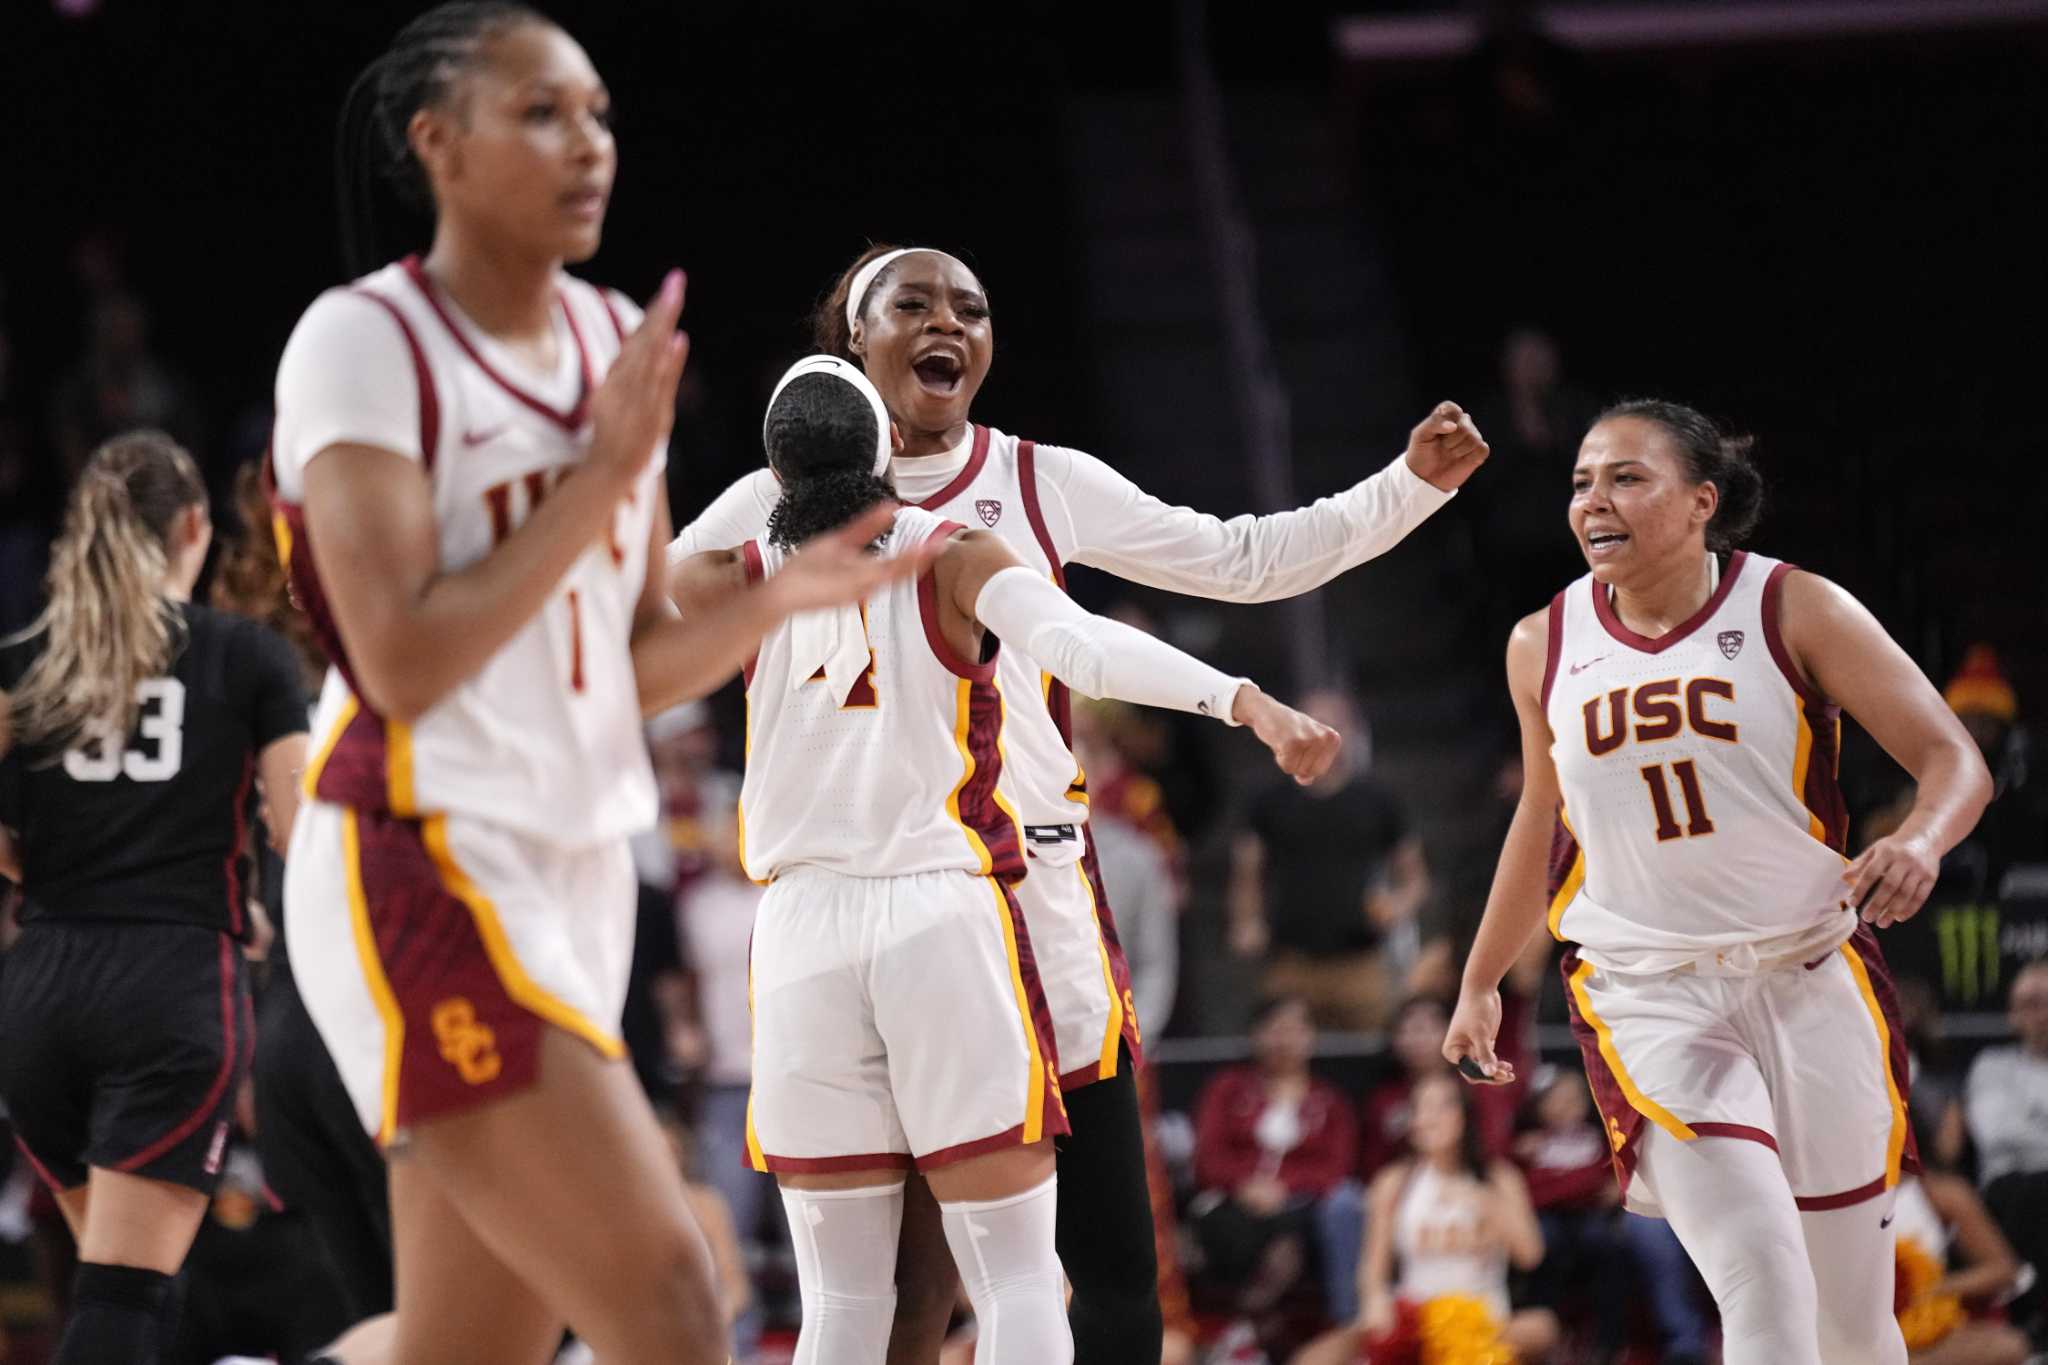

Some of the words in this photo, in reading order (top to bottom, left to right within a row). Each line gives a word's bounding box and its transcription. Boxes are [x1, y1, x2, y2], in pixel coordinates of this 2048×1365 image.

[64, 677, 187, 782] 33
[1582, 676, 1738, 757] USC
[1640, 758, 1717, 843] 11
[432, 996, 503, 1086] SC
